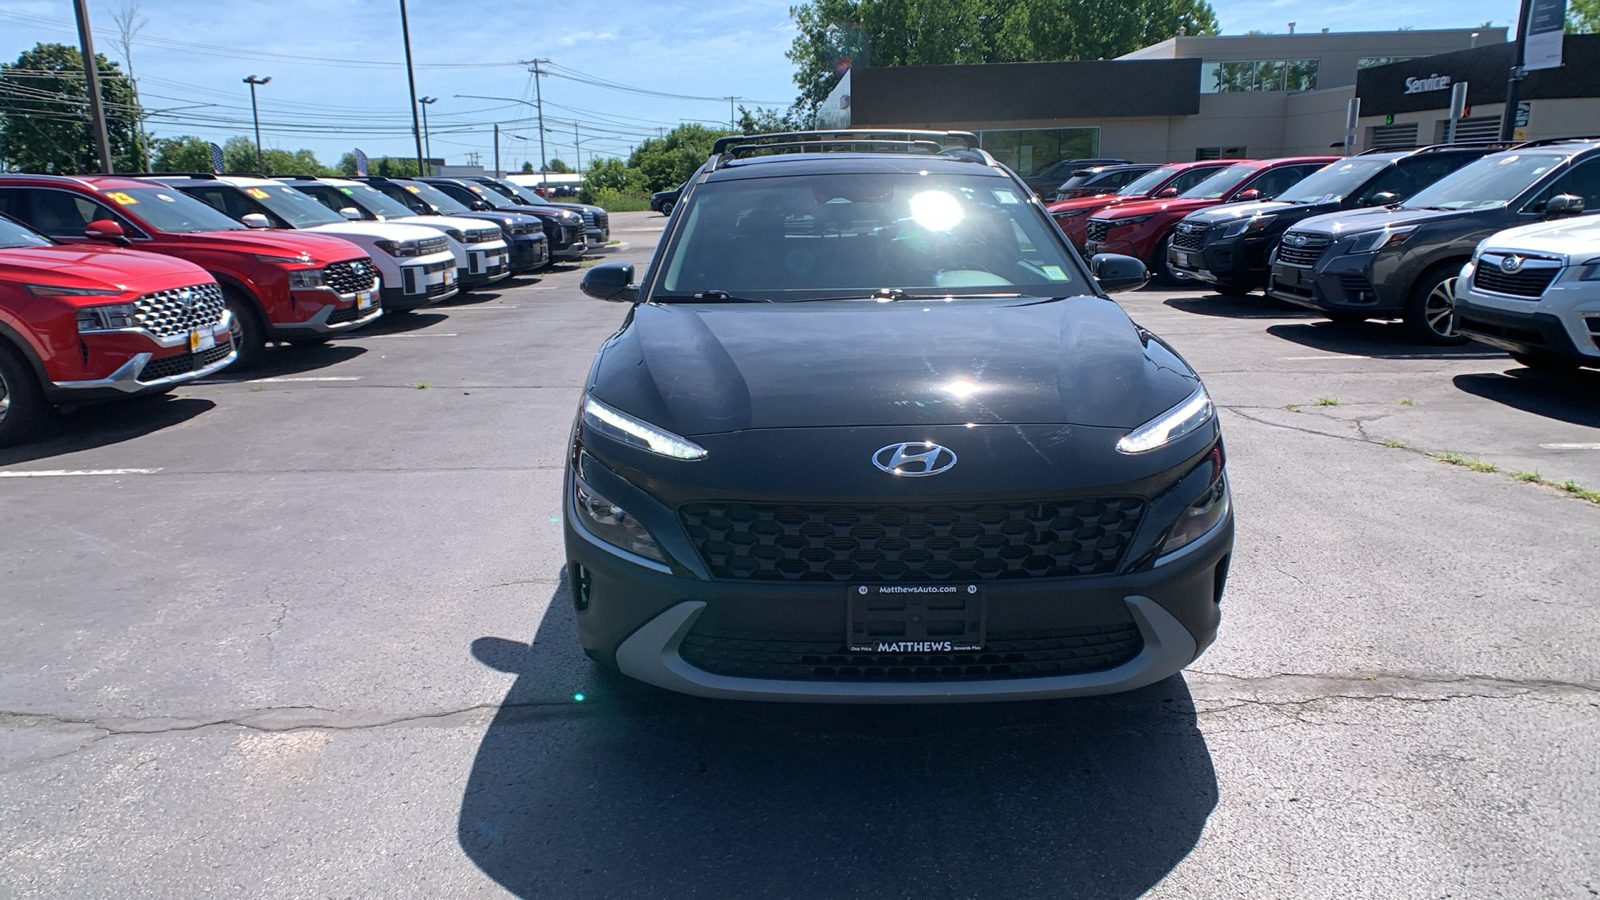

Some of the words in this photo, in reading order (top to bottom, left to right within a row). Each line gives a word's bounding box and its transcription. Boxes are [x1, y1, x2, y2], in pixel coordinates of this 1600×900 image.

[1404, 73, 1451, 94] Service
[879, 586, 957, 594] MatthewsAuto.com
[877, 641, 952, 653] MATTHEWS
